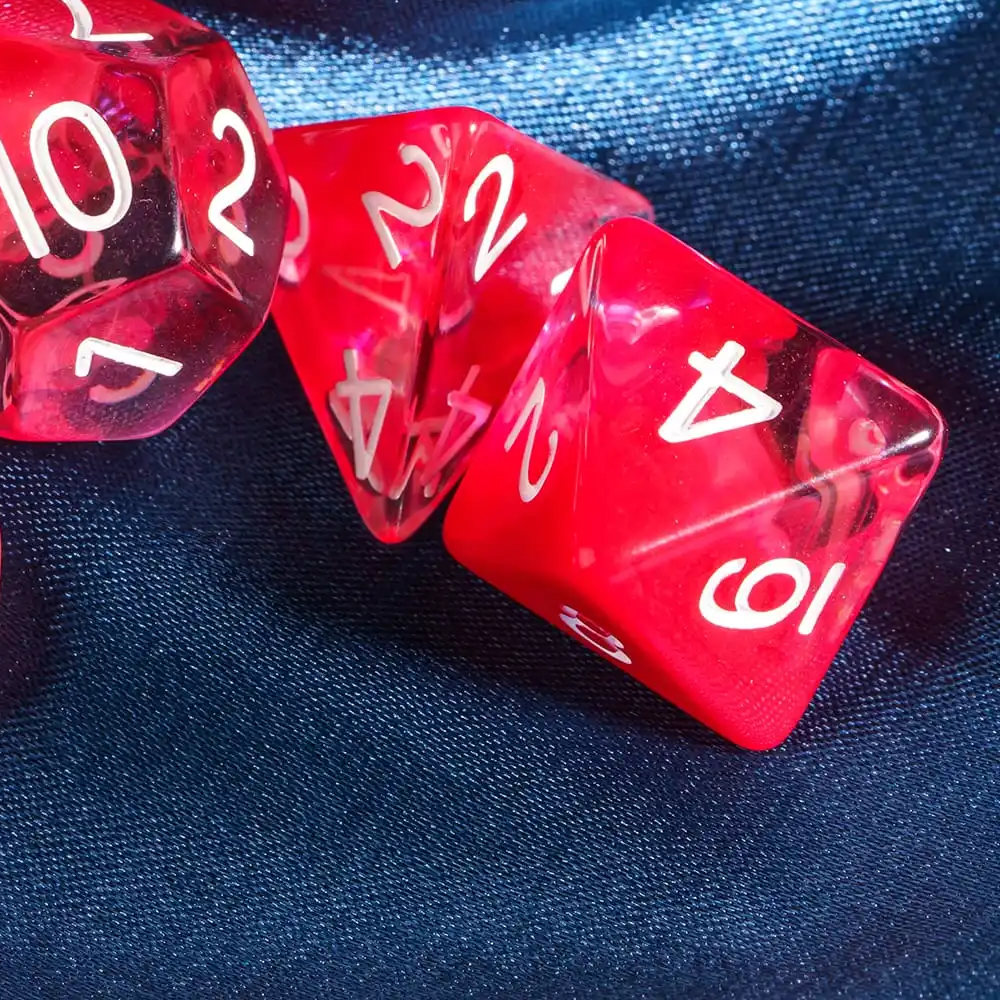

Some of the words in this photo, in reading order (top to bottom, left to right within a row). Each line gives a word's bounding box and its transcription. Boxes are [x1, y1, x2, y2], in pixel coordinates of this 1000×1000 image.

[208, 108, 256, 256] 2
[361, 144, 444, 269] 2
[463, 154, 527, 282] 2
[336, 349, 393, 479] 4
[504, 377, 558, 503] 2
[658, 340, 782, 444] 4
[699, 556, 846, 635] 6
